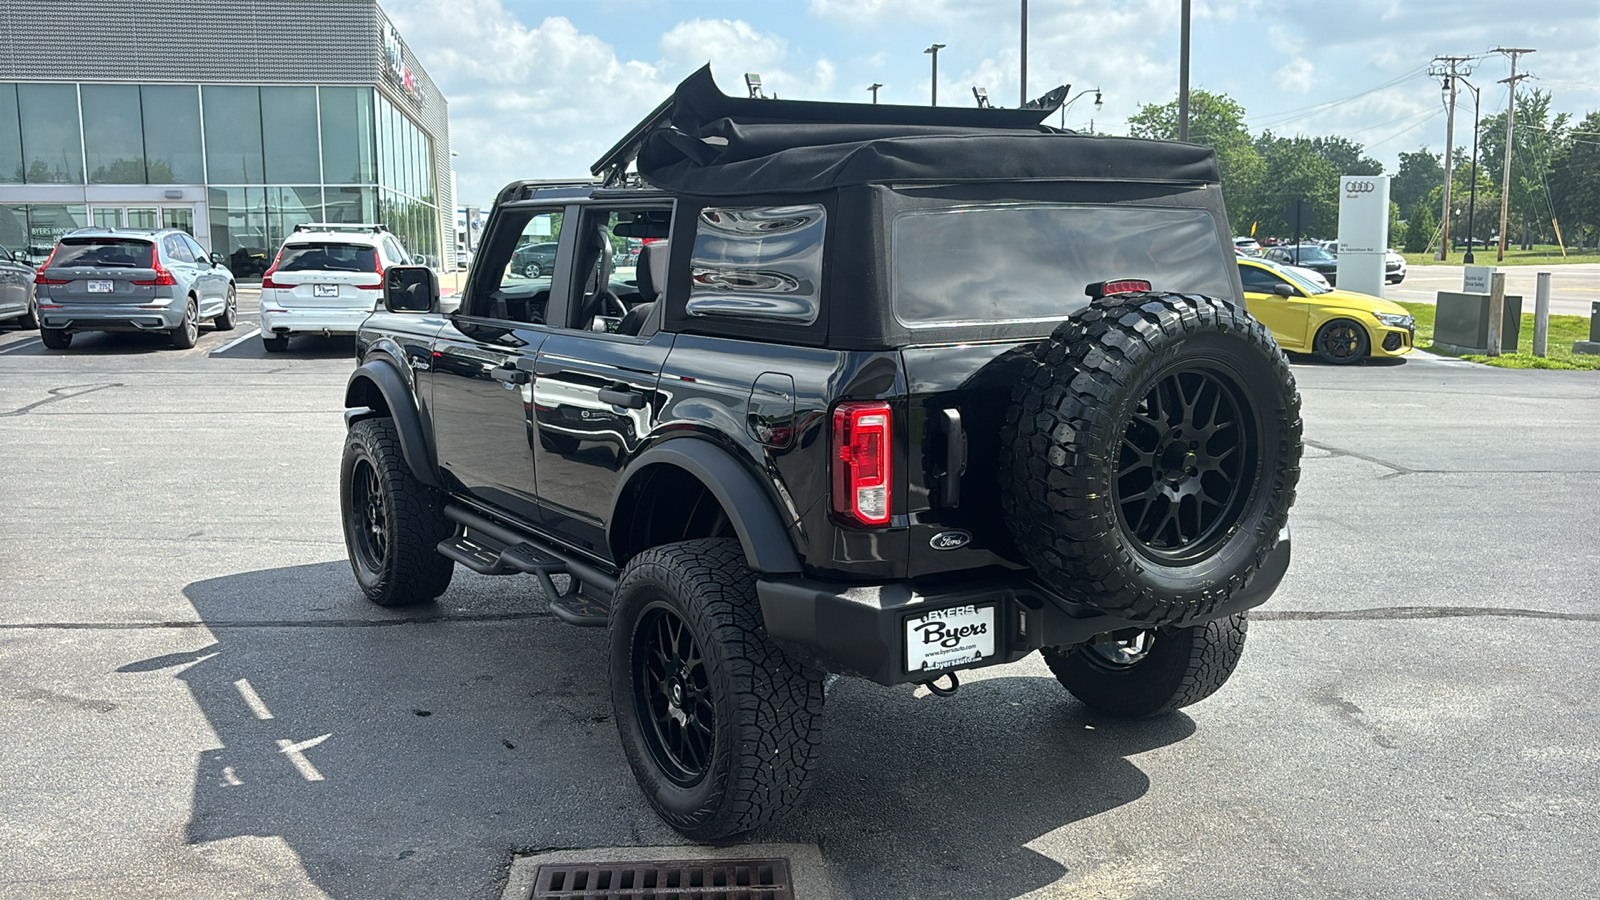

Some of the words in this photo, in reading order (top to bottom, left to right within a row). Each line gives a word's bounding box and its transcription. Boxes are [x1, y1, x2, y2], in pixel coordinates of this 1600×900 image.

[31, 227, 51, 235] BYERS
[940, 534, 963, 547] Ford
[928, 604, 976, 621] BYERS
[913, 621, 987, 647] Byers
[924, 644, 977, 658] www.byersauto.com
